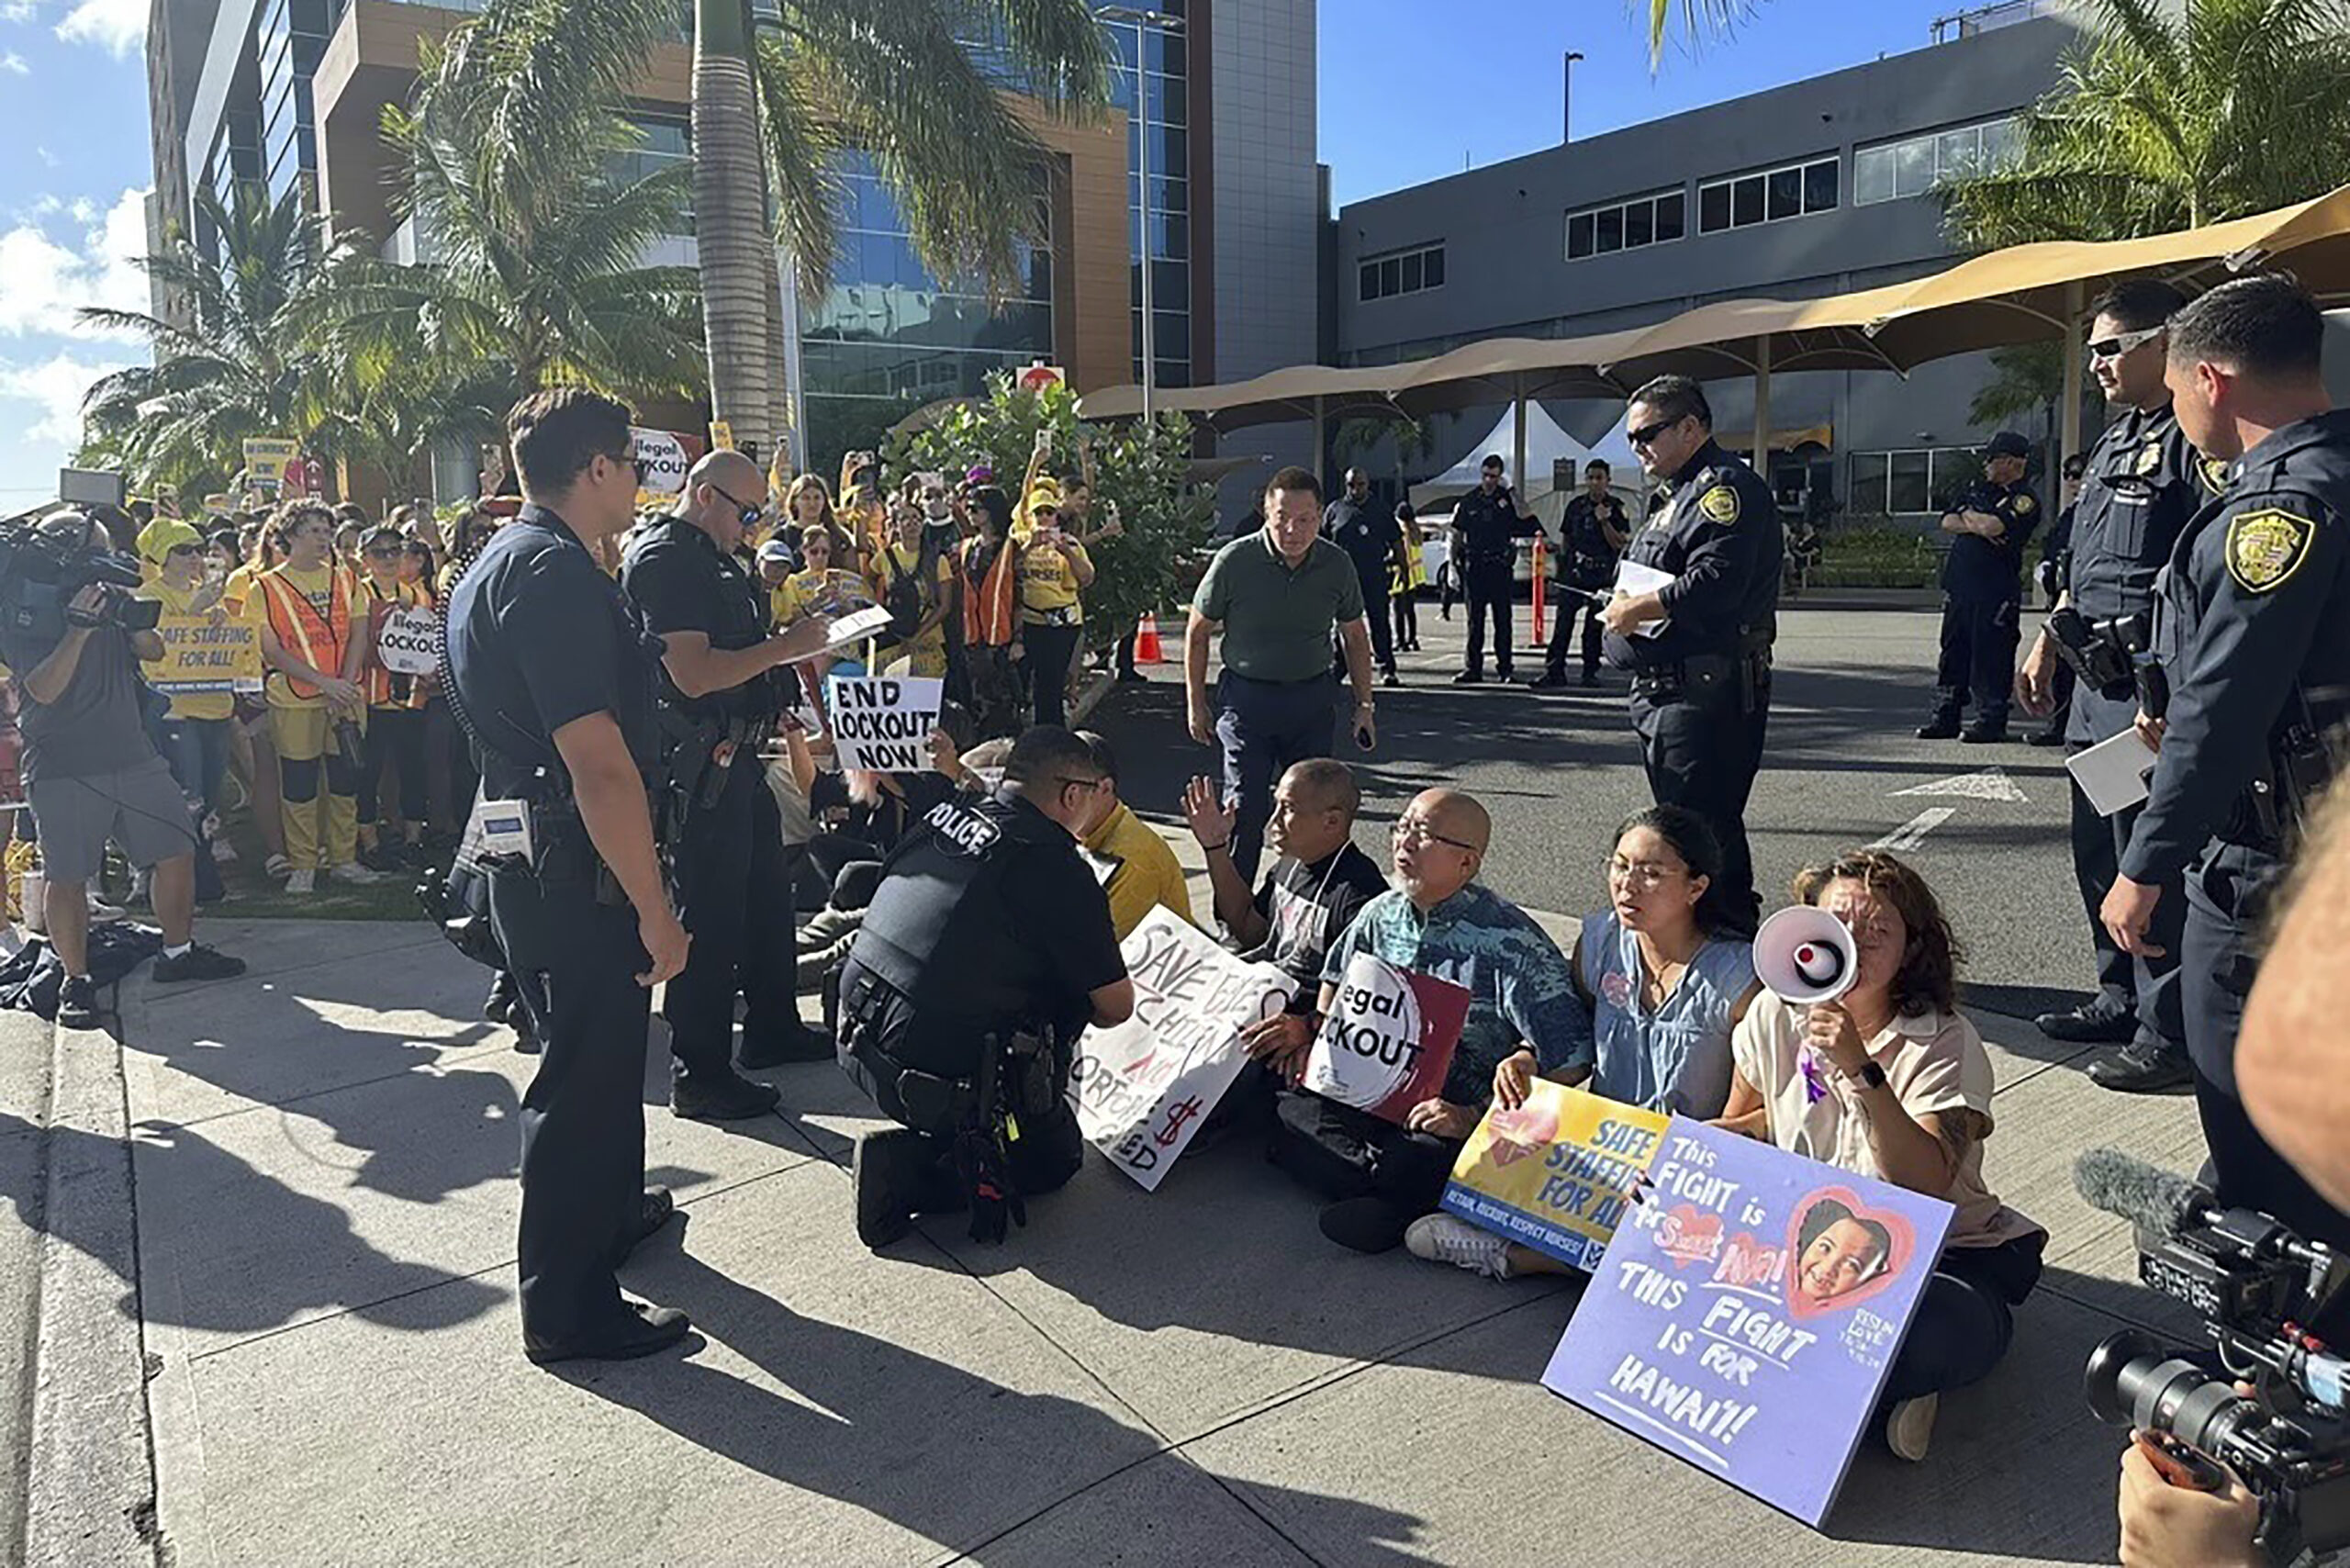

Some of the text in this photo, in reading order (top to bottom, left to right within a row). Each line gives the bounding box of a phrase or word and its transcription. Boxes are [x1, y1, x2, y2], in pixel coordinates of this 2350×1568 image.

[191, 626, 253, 644] STAFFING
[377, 633, 439, 655] LOCKOU
[178, 649, 206, 666] FOR
[836, 680, 901, 708] END
[833, 711, 937, 740] LOCKOUT
[856, 744, 919, 768] NOW
[923, 801, 992, 855] POLICE
[1128, 924, 1219, 1001] SAVE
[1590, 1119, 1657, 1159] SAFE
[1673, 1137, 1718, 1169] This
[1537, 1175, 1593, 1215] FOR
[1654, 1160, 1767, 1226] FIGHT is
[1510, 1215, 1547, 1239] RESPECT
[1617, 1260, 1688, 1310] THIS
[1702, 1294, 1818, 1362] FIGHT
[1656, 1322, 1759, 1387] IS FOR
